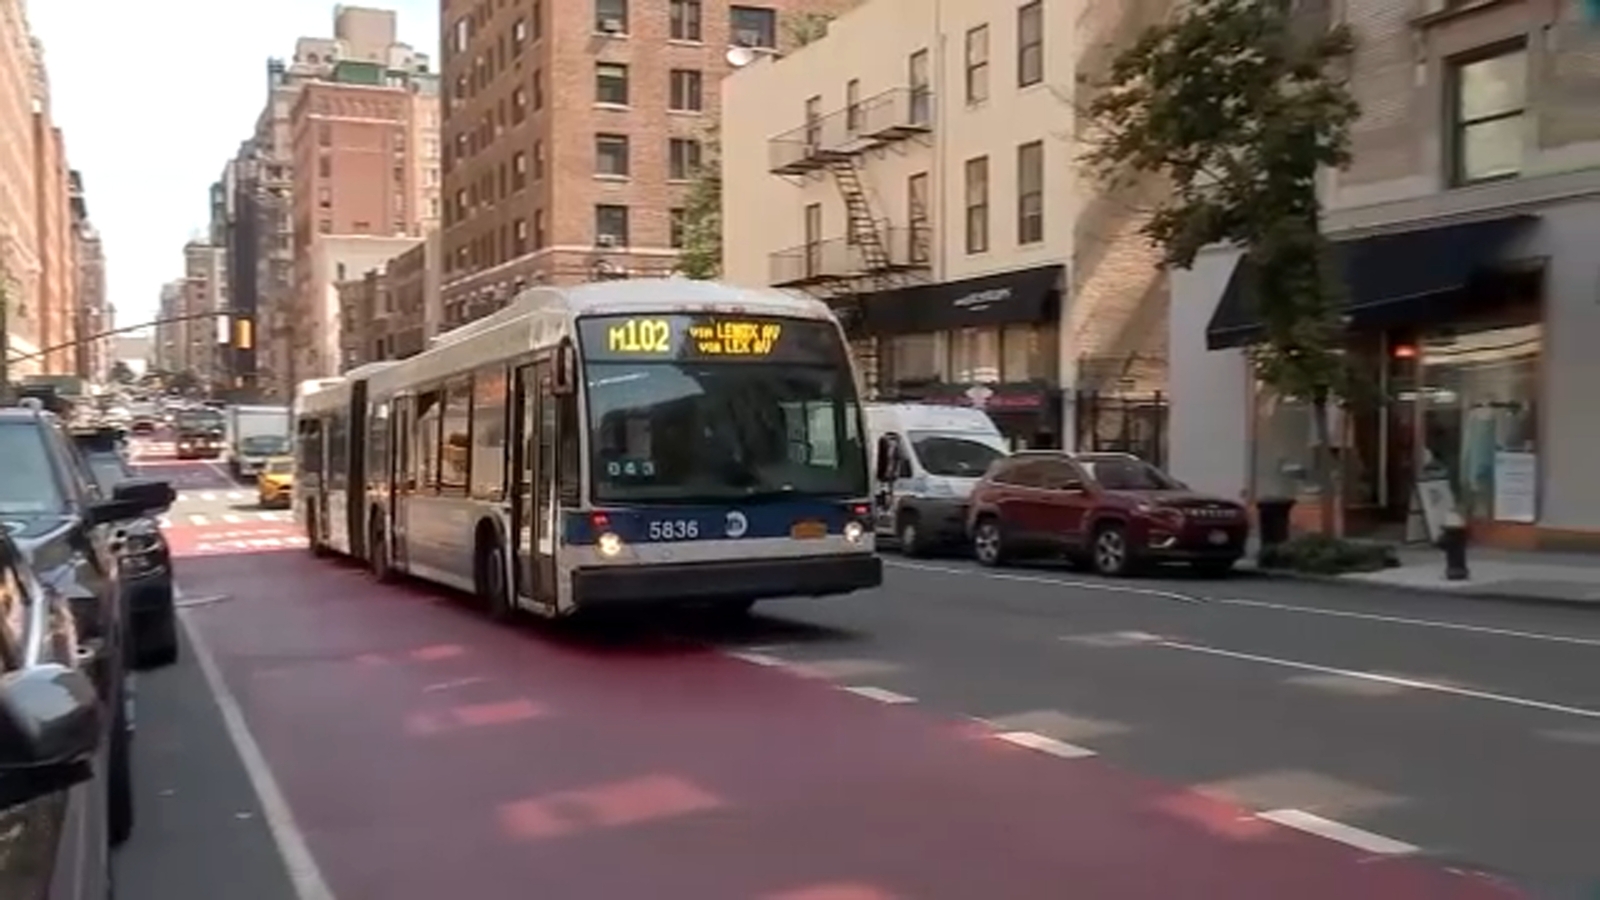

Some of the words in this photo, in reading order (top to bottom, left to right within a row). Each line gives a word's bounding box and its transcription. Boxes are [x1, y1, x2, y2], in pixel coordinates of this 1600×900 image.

[609, 319, 670, 352] M102
[724, 338, 752, 354] LEX
[649, 520, 699, 539] 5836
